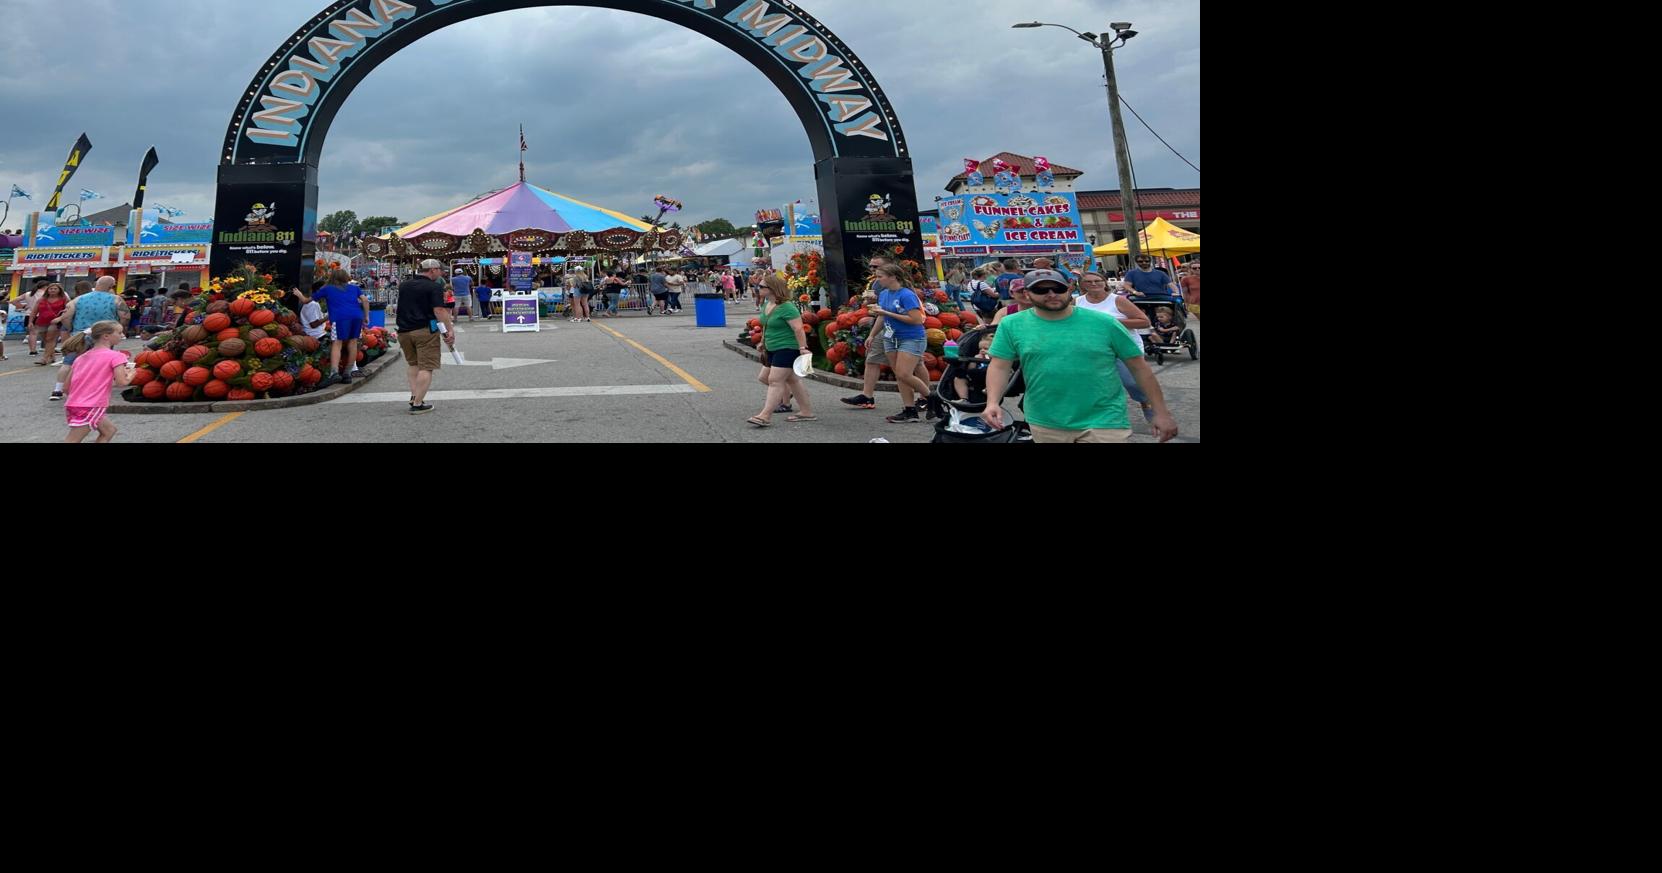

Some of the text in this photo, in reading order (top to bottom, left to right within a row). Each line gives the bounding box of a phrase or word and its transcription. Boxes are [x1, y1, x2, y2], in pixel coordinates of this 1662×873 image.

[246, 0, 417, 147] INDIANA
[723, 0, 888, 141] MIDWAY
[974, 203, 1070, 216] FUNNEL CAKES
[844, 220, 896, 231] Indiana
[896, 220, 914, 231] 811
[1033, 218, 1043, 227] &
[219, 231, 295, 243] Indiana 811
[1004, 230, 1078, 240] ICE CREAM
[25, 252, 95, 261] RIDE TICKETS
